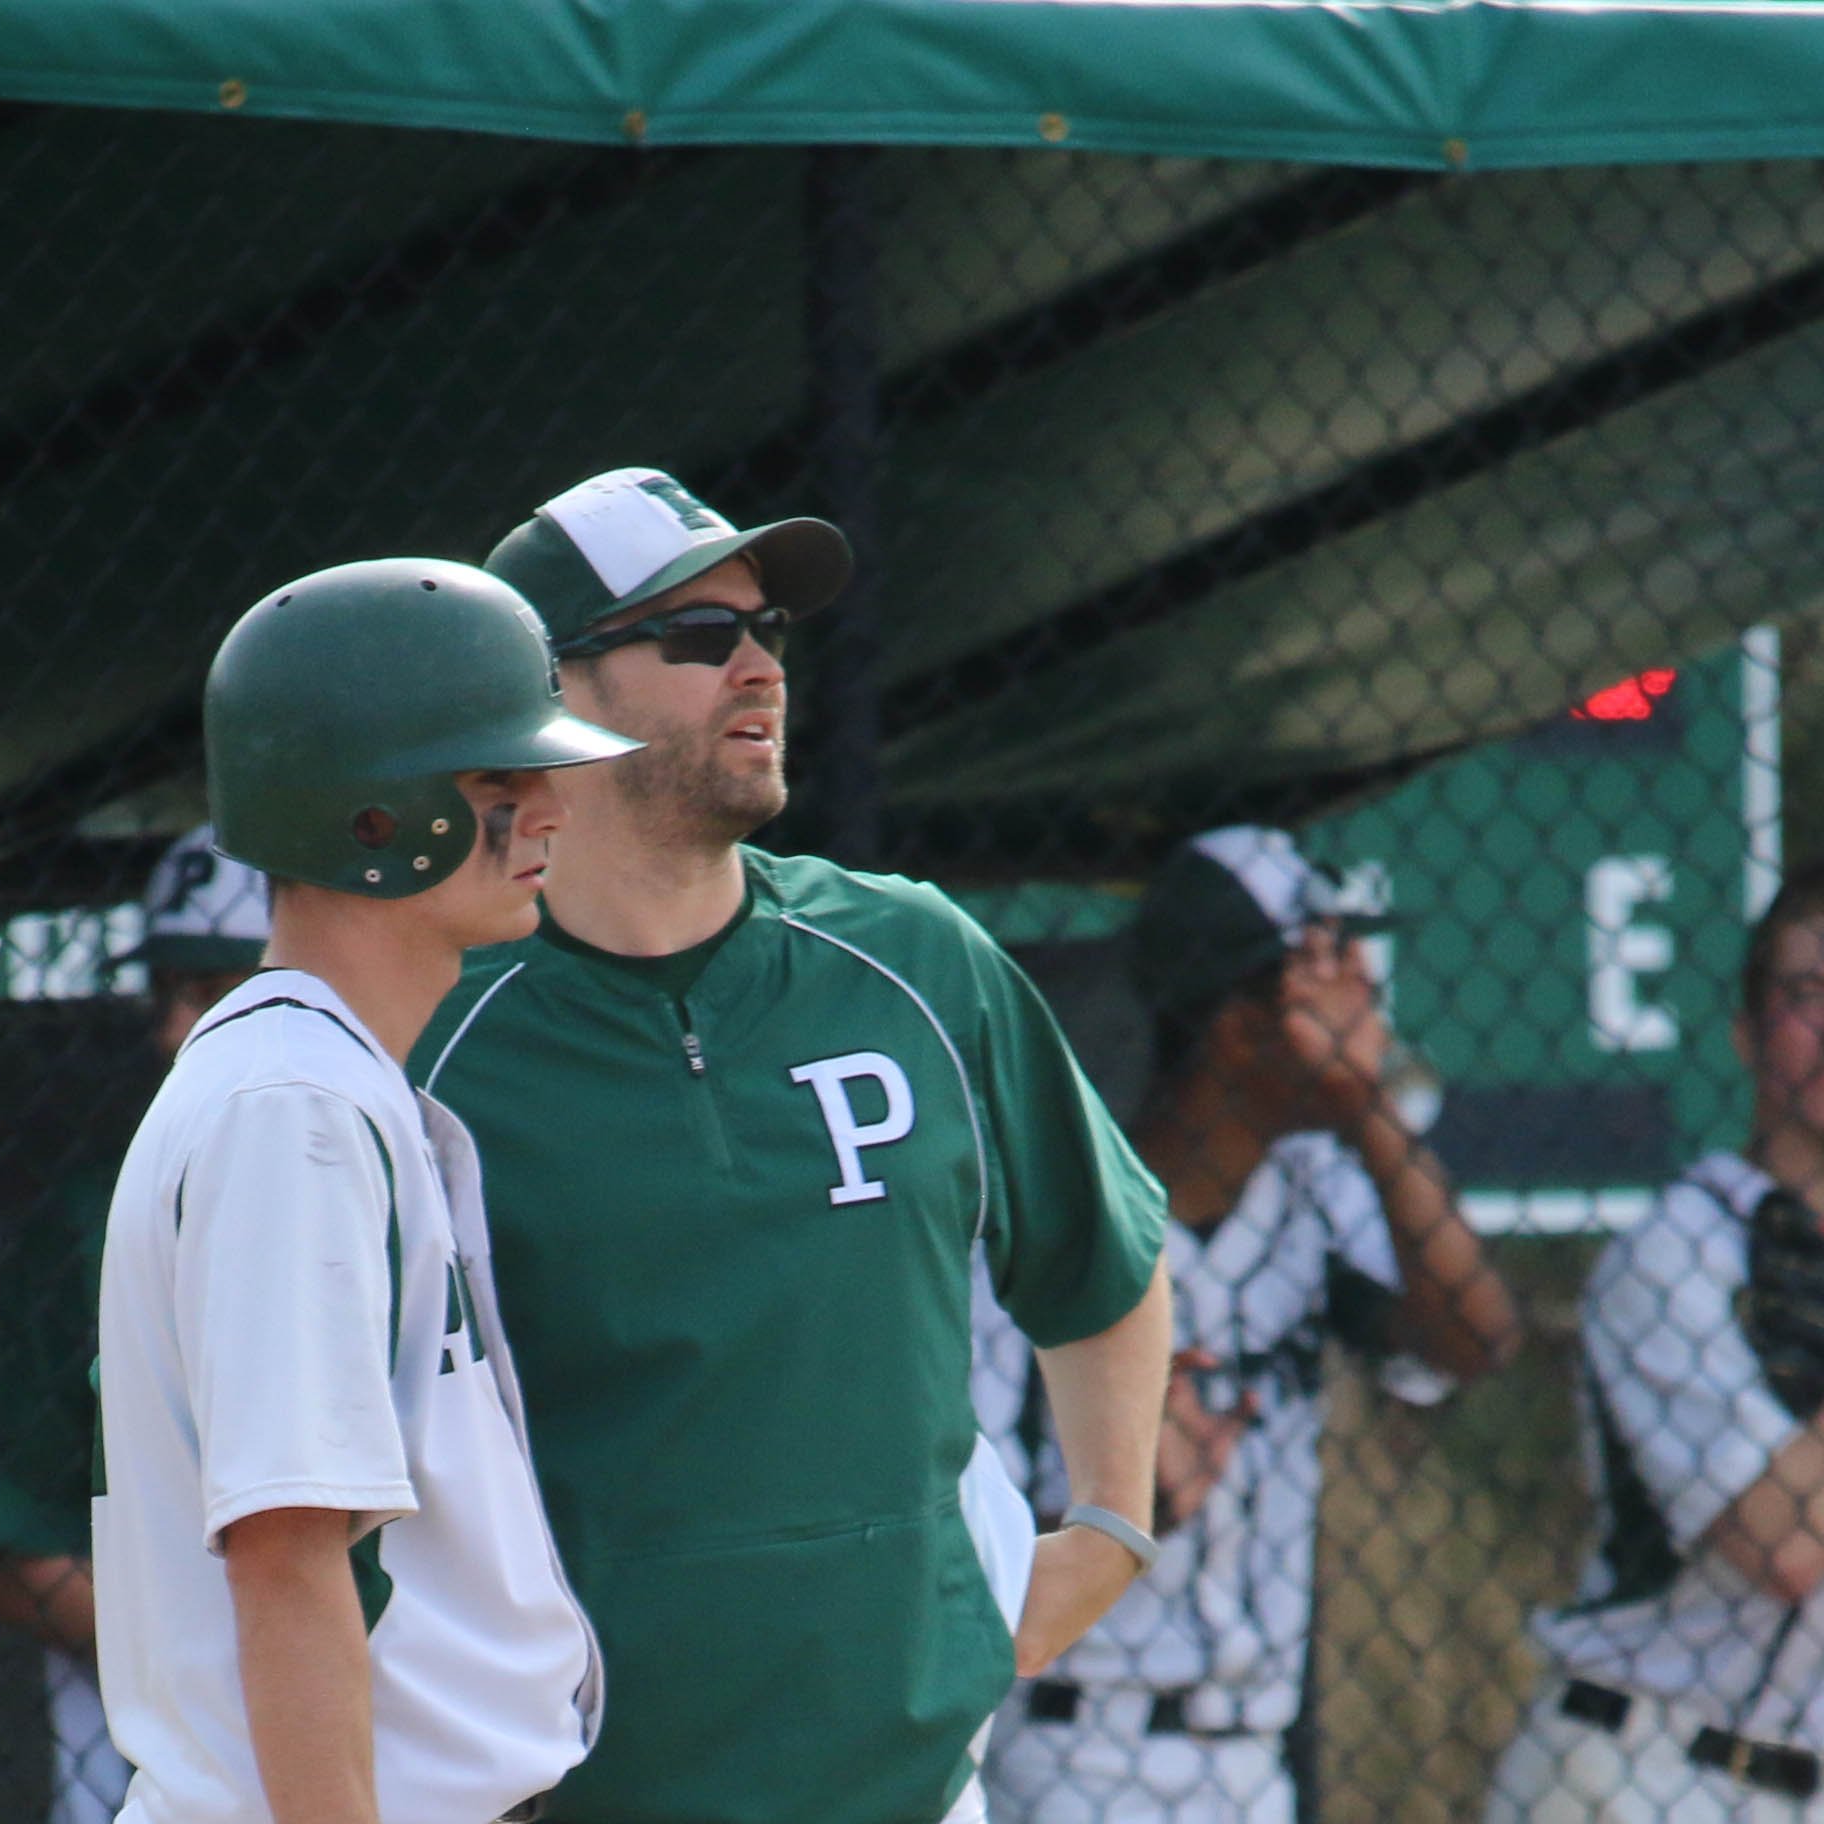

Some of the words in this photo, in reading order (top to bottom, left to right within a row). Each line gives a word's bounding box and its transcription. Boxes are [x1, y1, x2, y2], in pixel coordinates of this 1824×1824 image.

[166, 850, 215, 914] P
[1584, 856, 1679, 1052] E
[788, 1050, 917, 1206] P
